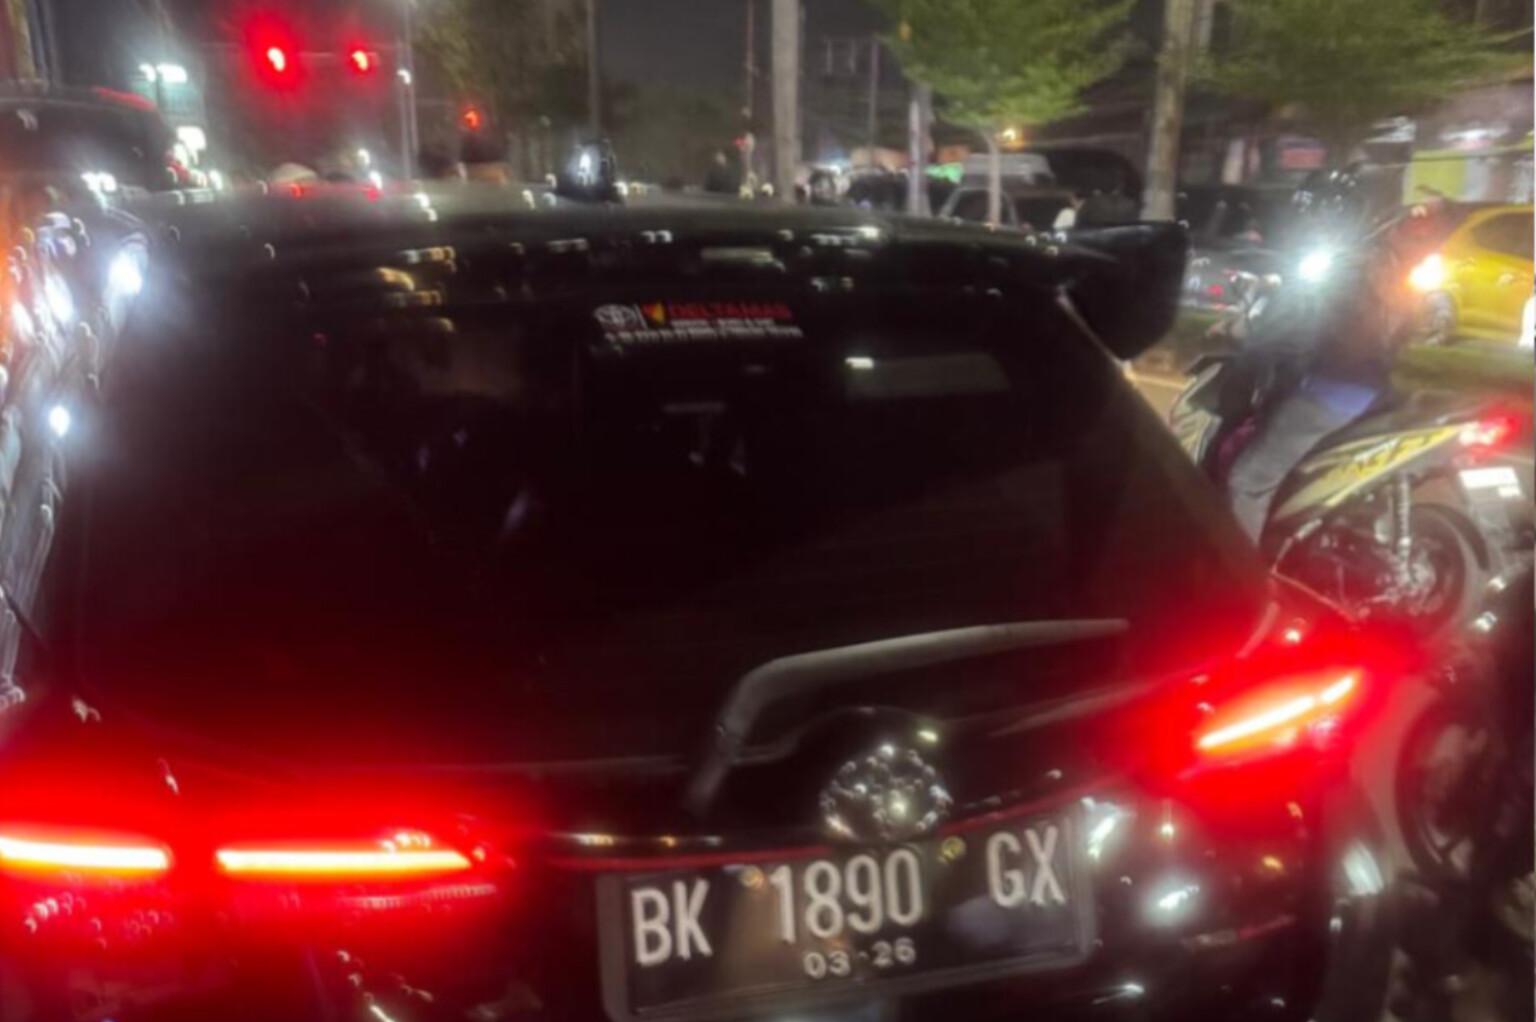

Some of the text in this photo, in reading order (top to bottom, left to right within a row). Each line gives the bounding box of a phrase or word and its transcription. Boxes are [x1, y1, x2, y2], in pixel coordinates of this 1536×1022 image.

[632, 826, 1066, 966] BK 1890 GX
